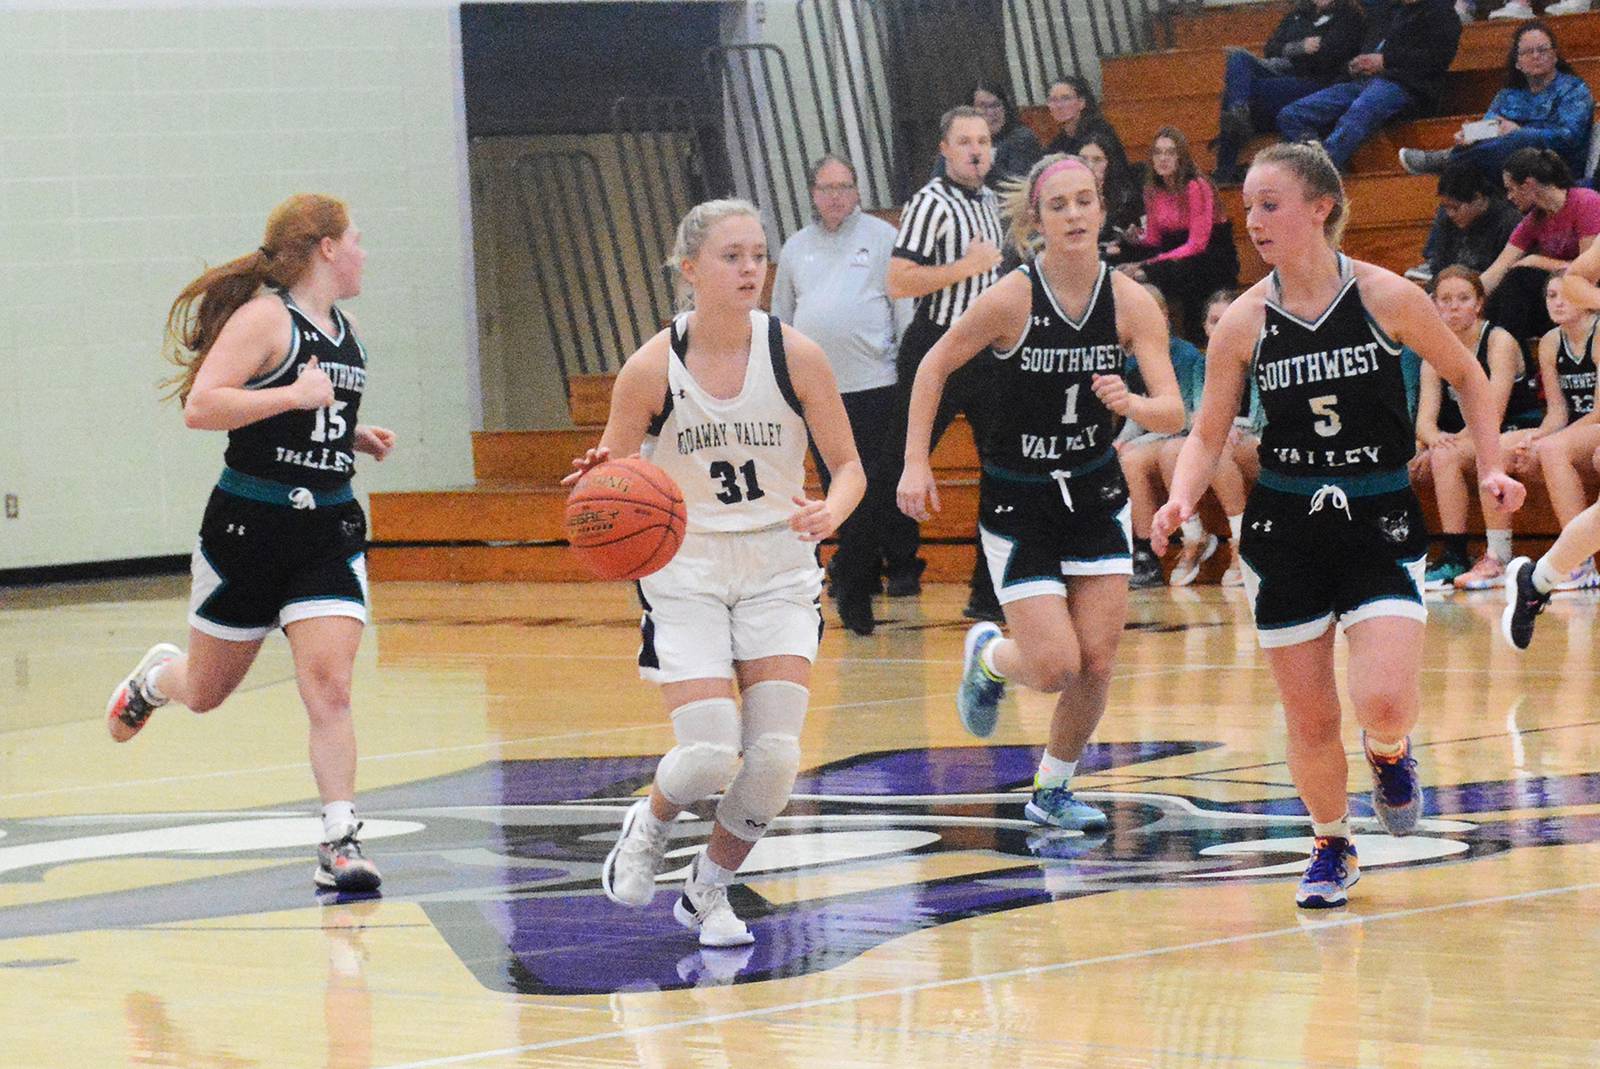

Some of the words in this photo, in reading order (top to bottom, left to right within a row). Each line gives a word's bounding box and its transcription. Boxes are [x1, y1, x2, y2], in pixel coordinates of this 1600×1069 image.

[1020, 344, 1123, 373] SOUTHWEST
[1258, 342, 1379, 391] SOUTHWEST
[310, 400, 347, 443] 15
[1061, 383, 1080, 424] 1
[1308, 394, 1342, 438] 5
[734, 422, 782, 446] VALLEY
[710, 459, 765, 505] 31
